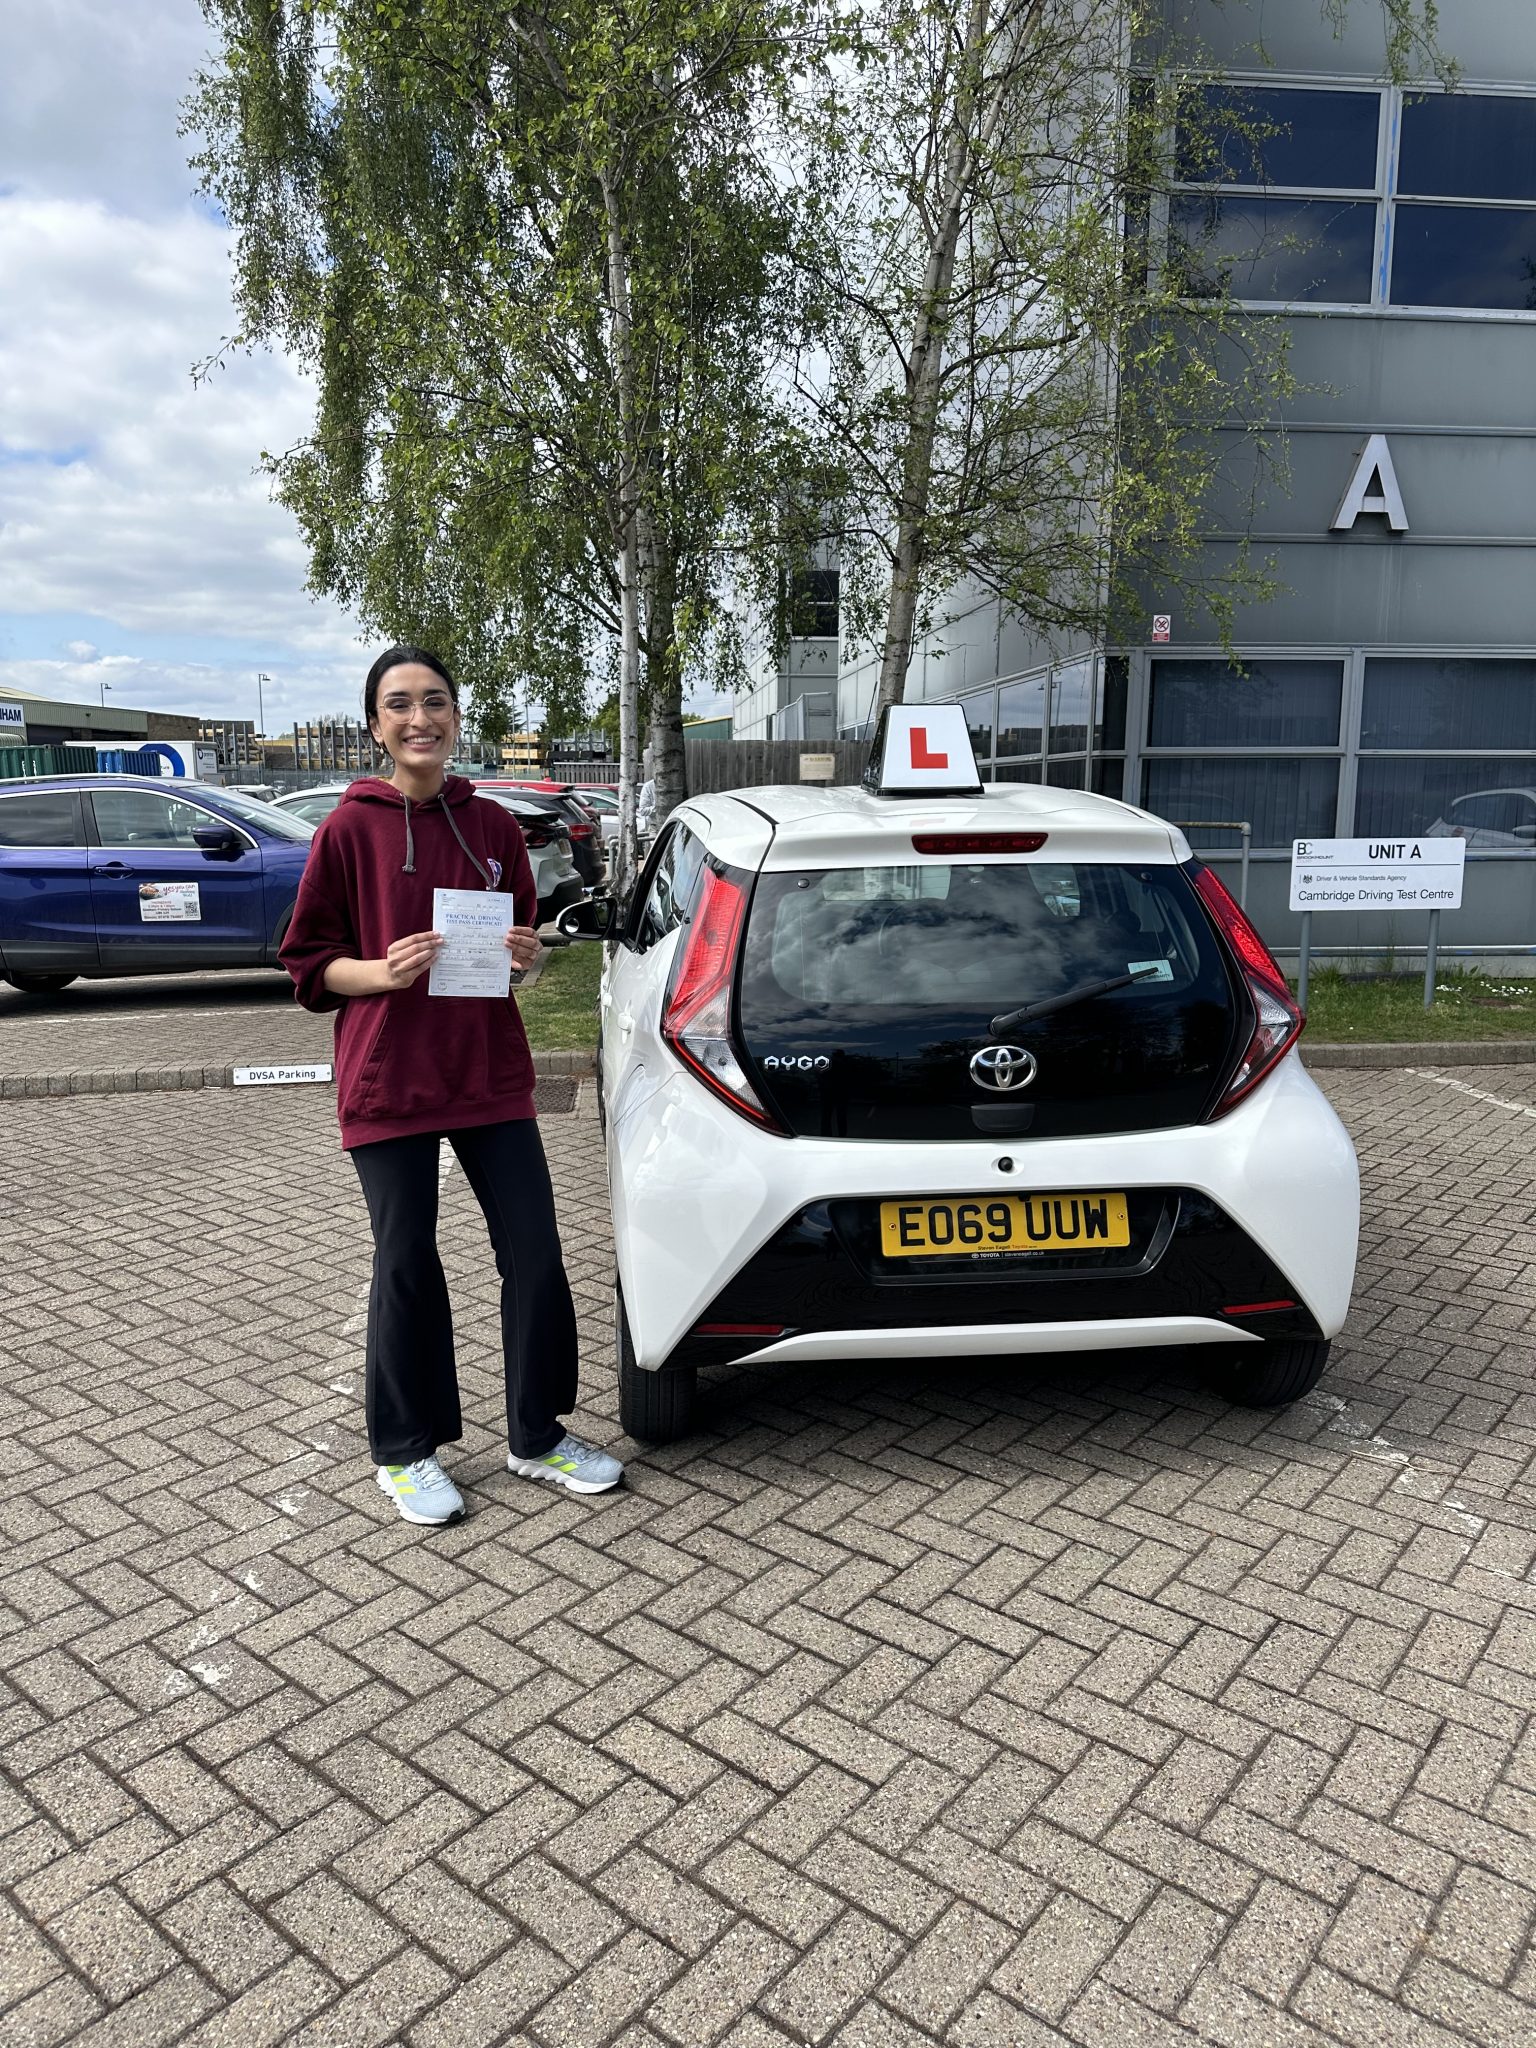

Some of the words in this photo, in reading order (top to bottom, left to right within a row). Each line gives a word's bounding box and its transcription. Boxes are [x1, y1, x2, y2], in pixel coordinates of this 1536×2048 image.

[1329, 434, 1409, 530] A
[910, 728, 948, 769] L
[1368, 844, 1406, 859] UNIT
[1410, 844, 1422, 858] A
[1387, 874, 1407, 882] Agency
[1298, 890, 1355, 902] Cambridge
[1358, 889, 1394, 902] Driving
[1396, 889, 1418, 899] Test
[1420, 889, 1454, 899] Centre
[764, 1055, 830, 1071] AYGO
[249, 1071, 275, 1080] DVSA
[278, 1070, 316, 1079] Parking
[899, 1203, 1013, 1247] EO69
[1025, 1199, 1109, 1241] UUW
